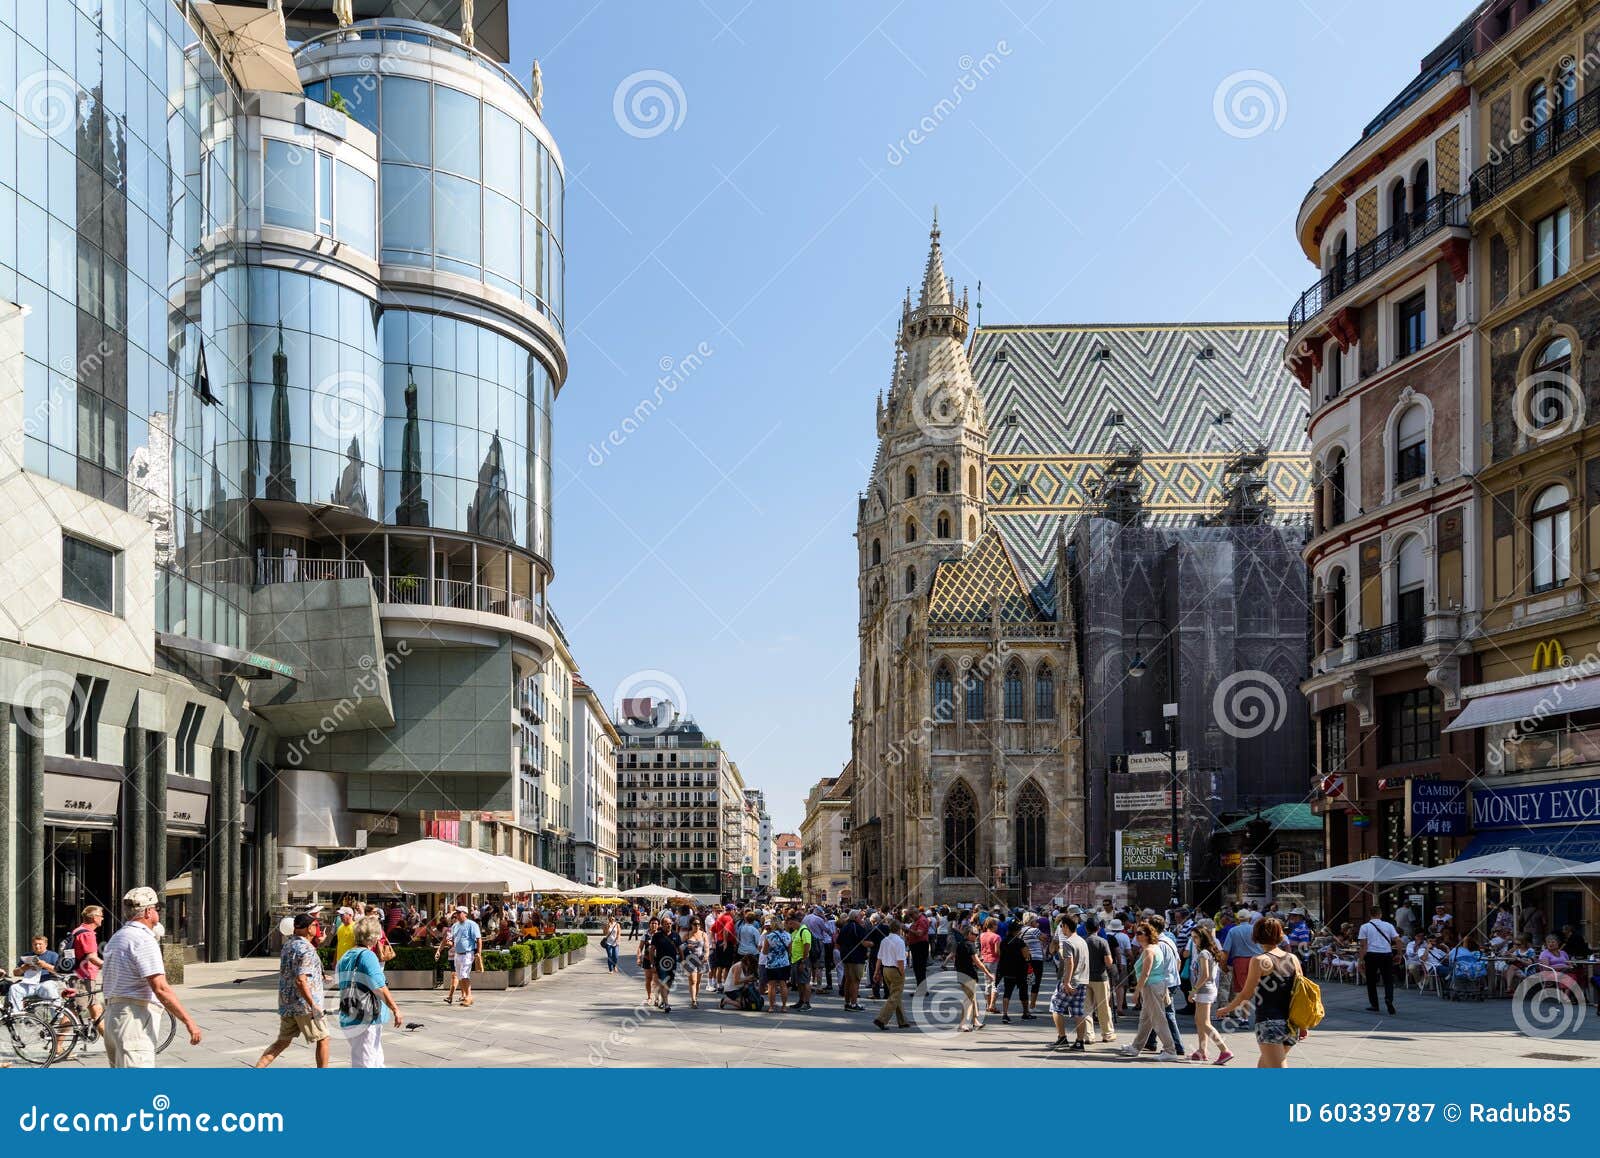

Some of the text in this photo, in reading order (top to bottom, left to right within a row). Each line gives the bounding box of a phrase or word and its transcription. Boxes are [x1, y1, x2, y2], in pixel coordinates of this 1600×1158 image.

[1418, 785, 1460, 796] CAMBIO
[1412, 801, 1466, 815] CHANGE
[1473, 792, 1545, 824] MONEY
[1123, 846, 1151, 856] MONET
[1123, 855, 1158, 864] PICASSO
[1124, 871, 1175, 881] ALBERTIN
